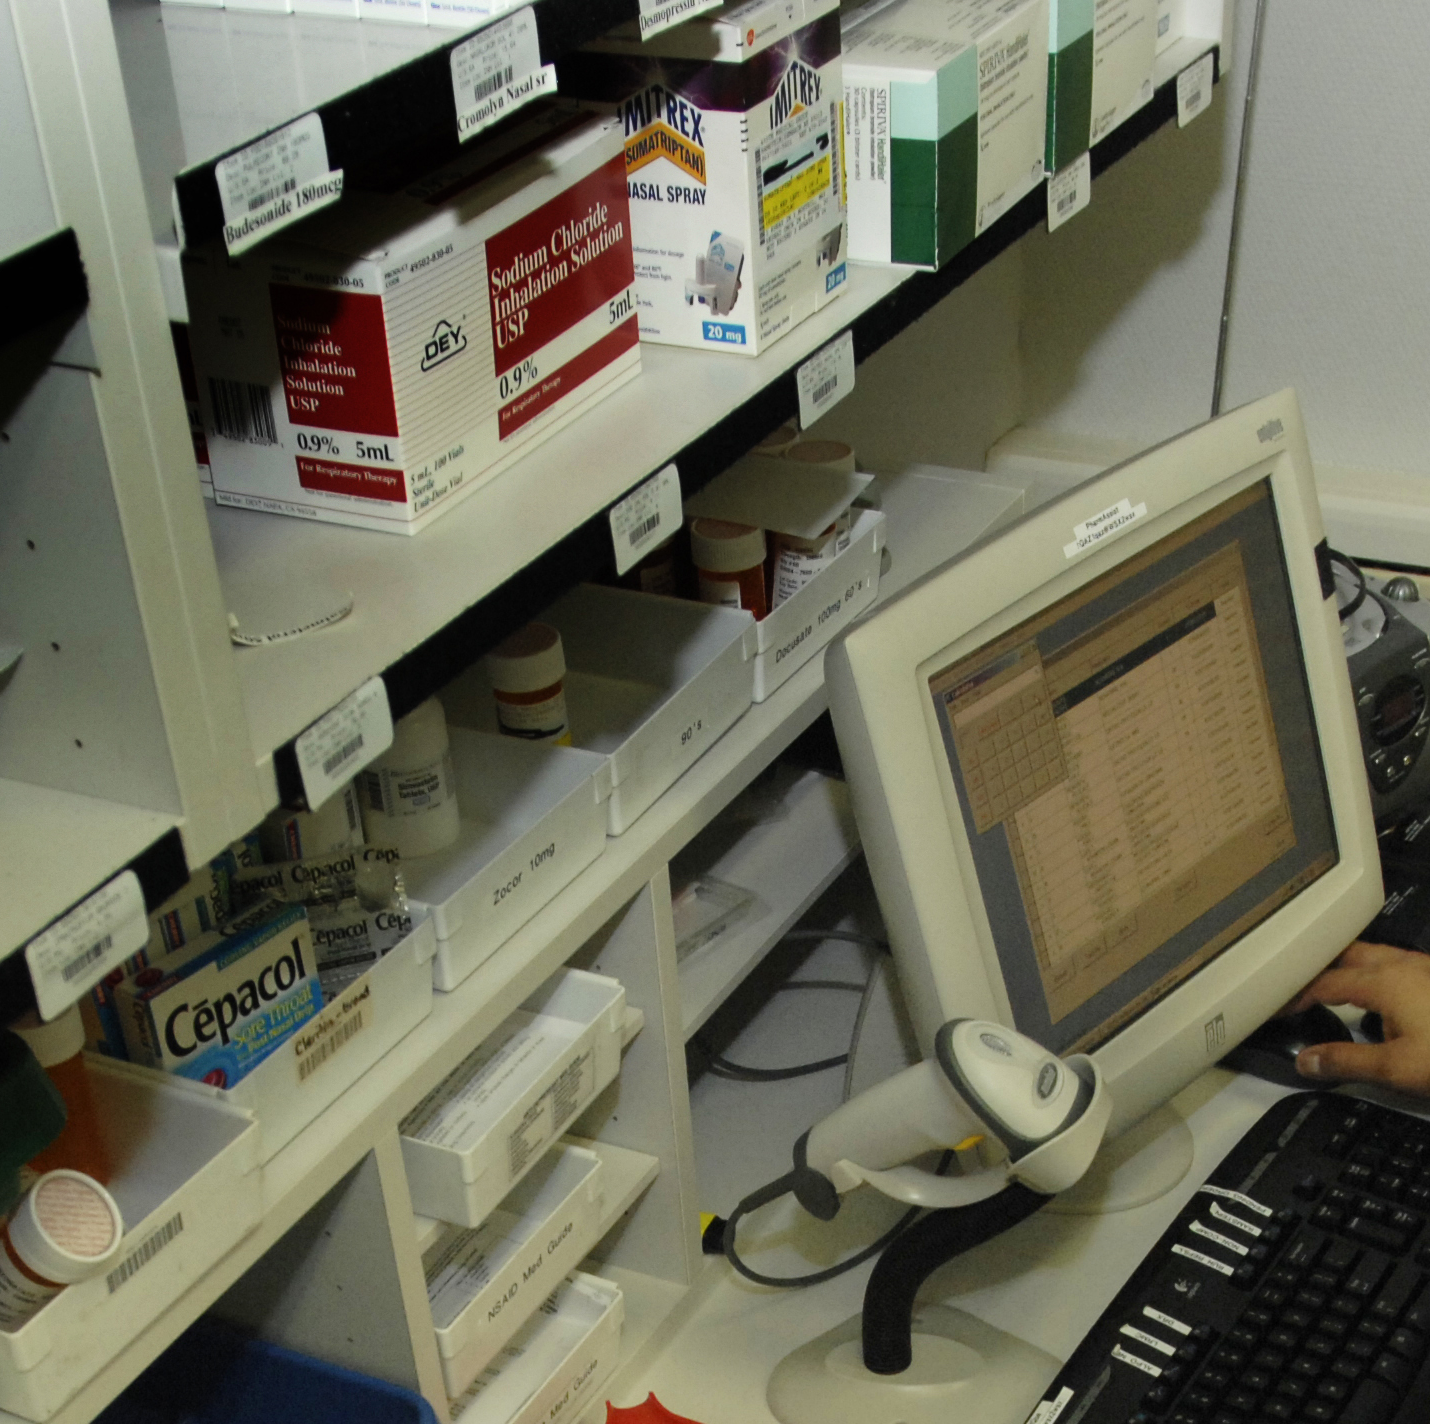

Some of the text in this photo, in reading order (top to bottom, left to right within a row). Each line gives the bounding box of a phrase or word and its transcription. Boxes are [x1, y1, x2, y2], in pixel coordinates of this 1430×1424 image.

[978, 47, 1005, 79] SPIRIVA
[456, 91, 505, 134] Cromolyn
[505, 77, 534, 102] Nasal
[770, 60, 821, 129] IMITREX
[875, 88, 888, 185] SPIRIVA HandiHaler
[224, 176, 344, 245] Budesonide 180mcg
[666, 186, 707, 206] SPRAY
[490, 201, 608, 296] Sodium Chloride
[491, 221, 624, 322] Inhalation Solution
[277, 314, 331, 336] Sodium
[609, 288, 634, 325] 5mL
[280, 335, 342, 357] Chloride
[423, 324, 463, 363] DEY
[495, 310, 529, 350] USP
[707, 324, 743, 344] 20 mg
[283, 355, 357, 378] Inhalation
[285, 375, 345, 396] Solution
[498, 355, 539, 401] 0.9%
[289, 395, 320, 412] USP
[502, 376, 562, 421] For Respiratory Therapy
[296, 432, 395, 462] 0.9% 5mL
[433, 456, 448, 473] 100
[447, 444, 465, 464] Vials
[300, 461, 399, 486] For Respiratory Therapy
[411, 478, 436, 498] Sterile
[449, 471, 464, 492] Vial
[774, 624, 813, 664] Docusate
[817, 601, 842, 627] 100mg
[492, 841, 557, 907] Zocor 10mg
[233, 983, 314, 1047] Sore Throat
[486, 1220, 574, 1323] NSAID Med Guide
[549, 1391, 571, 1420] Med
[573, 1358, 599, 1392] Guide
